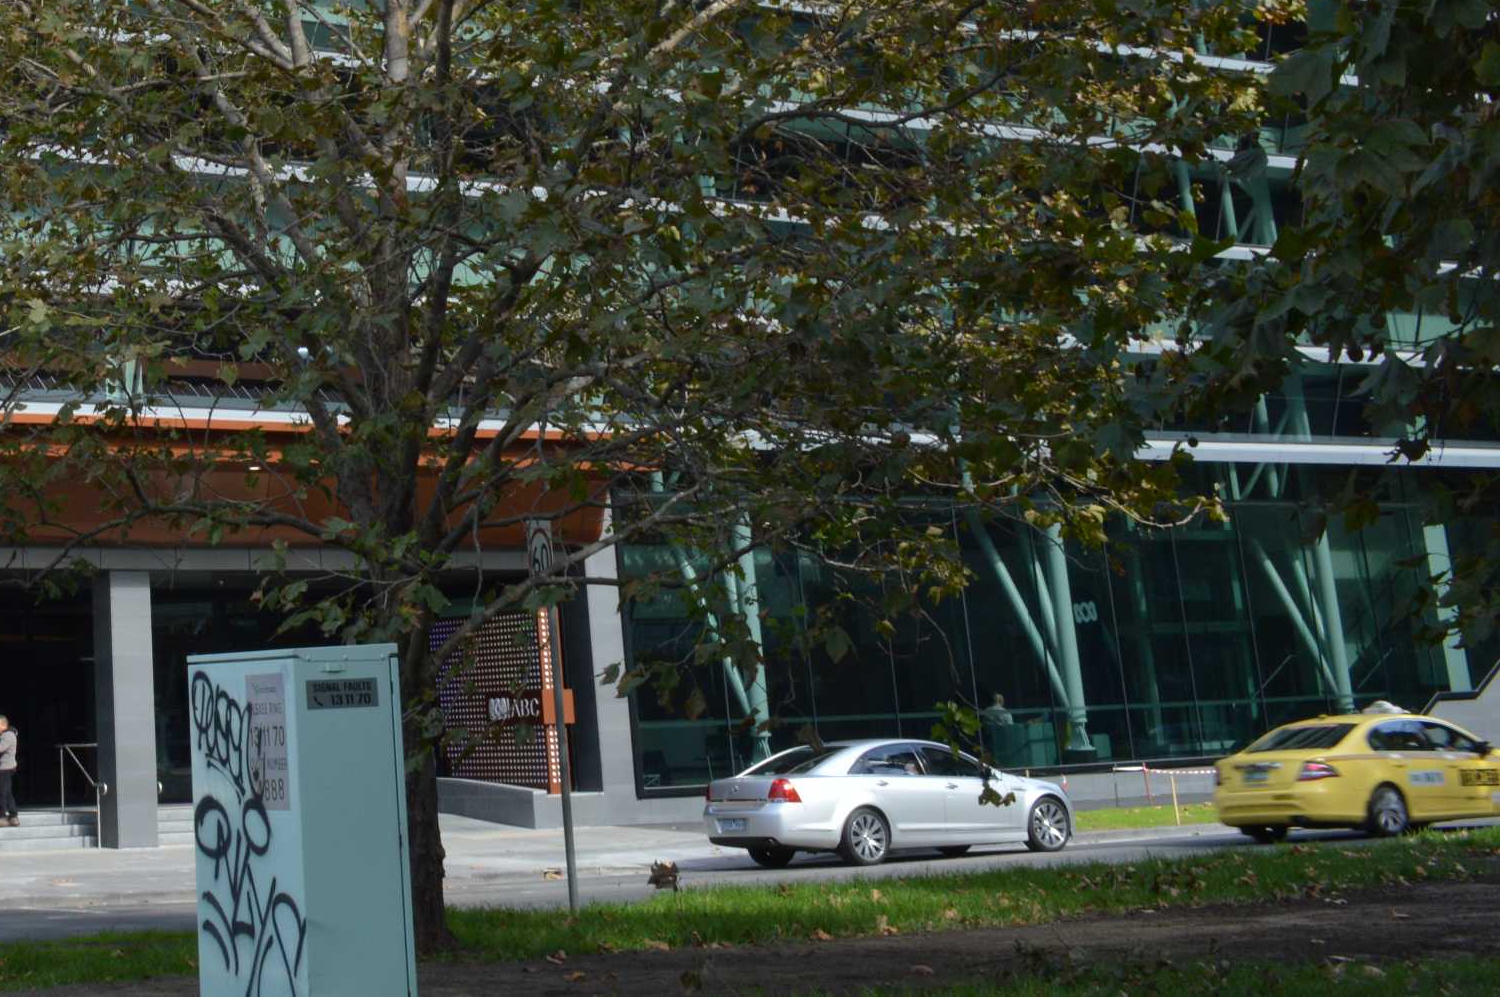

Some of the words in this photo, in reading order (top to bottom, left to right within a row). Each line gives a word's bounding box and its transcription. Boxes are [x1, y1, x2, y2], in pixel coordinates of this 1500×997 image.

[532, 543, 549, 574] 60
[356, 692, 372, 705] 70
[511, 697, 539, 718] ABC
[272, 725, 285, 747] 70
